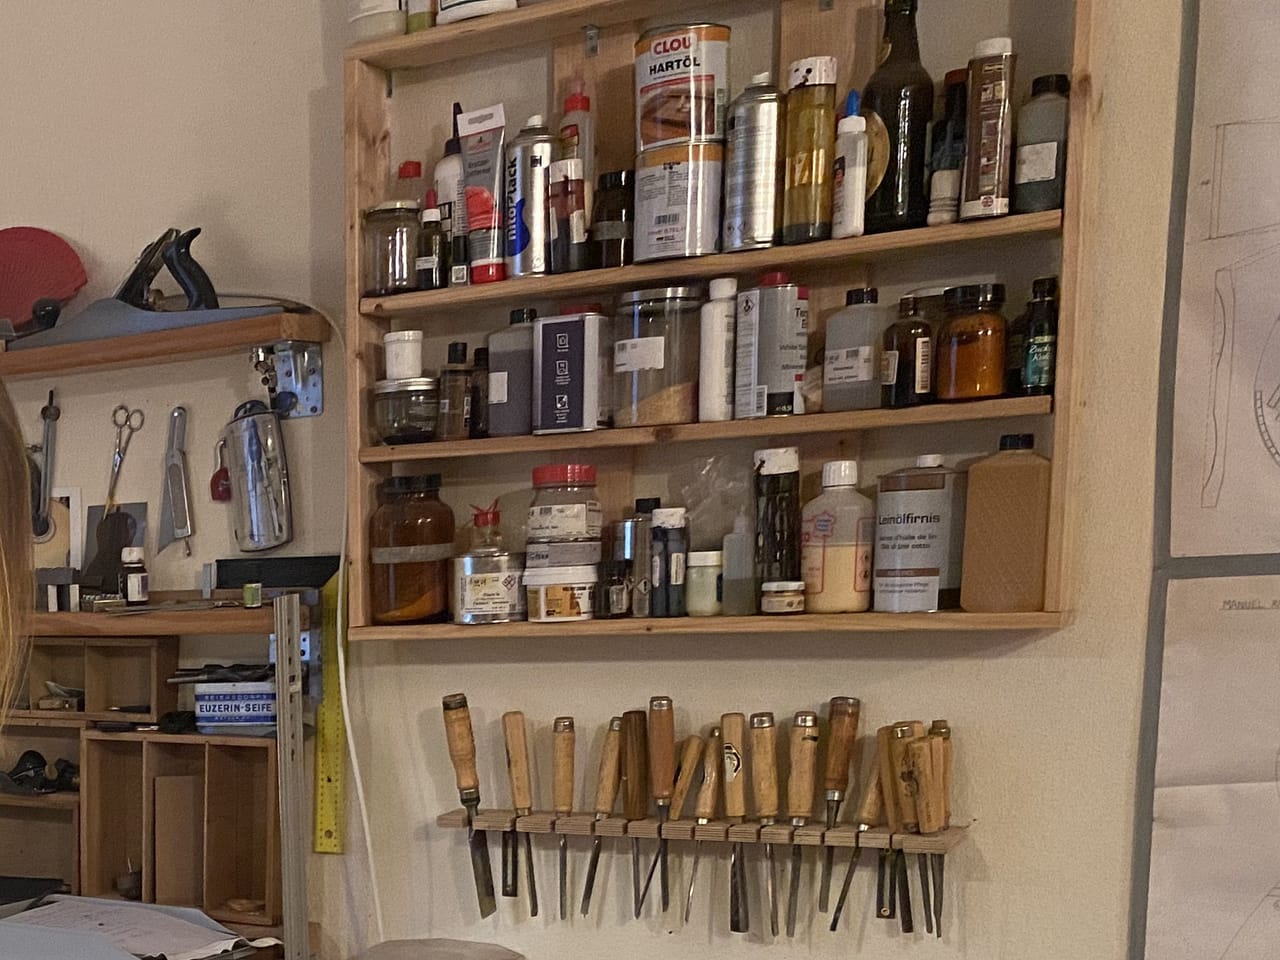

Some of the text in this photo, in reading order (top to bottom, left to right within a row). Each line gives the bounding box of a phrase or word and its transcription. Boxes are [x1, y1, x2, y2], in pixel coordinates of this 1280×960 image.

[653, 36, 692, 55] CLOU
[649, 55, 701, 75] HARTÖL
[878, 512, 941, 526] Leinölfirnis
[199, 702, 273, 713] EUZERIN-SEIFE
